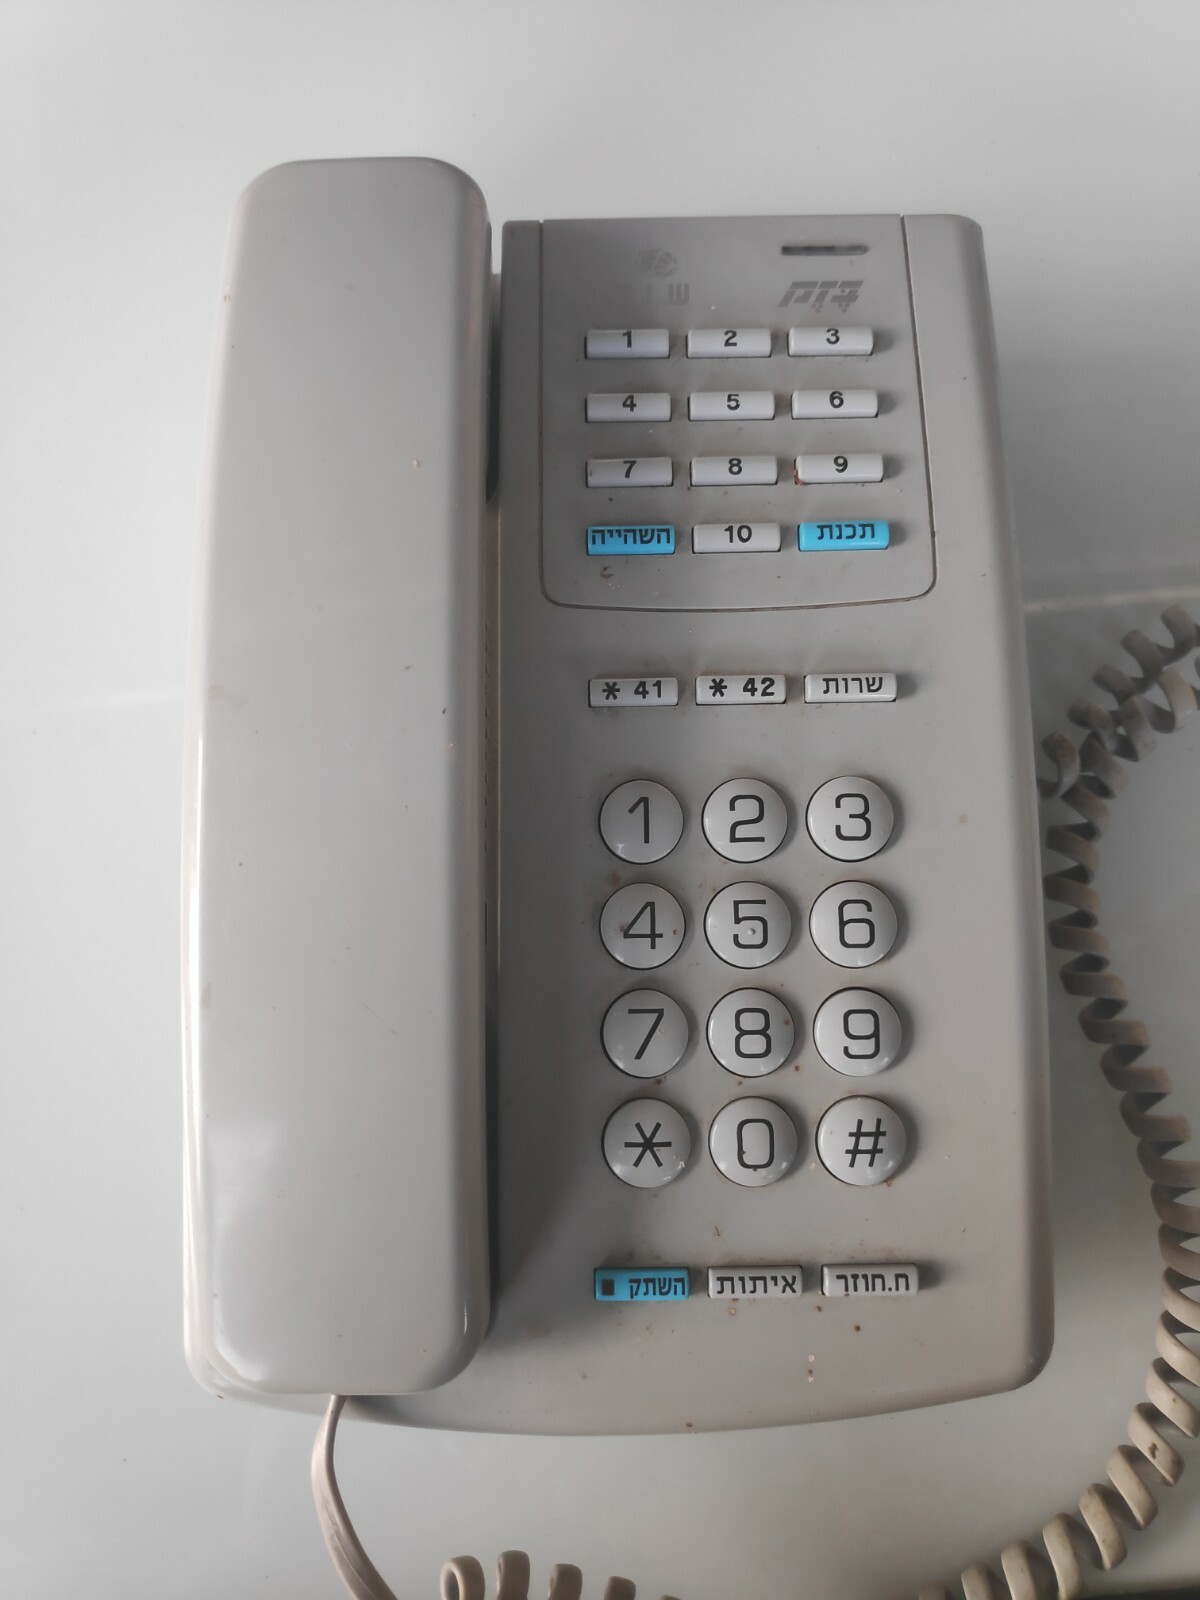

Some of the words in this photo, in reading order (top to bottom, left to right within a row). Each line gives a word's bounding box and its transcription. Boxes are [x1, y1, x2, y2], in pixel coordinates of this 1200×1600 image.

[622, 331, 633, 348] 1
[724, 330, 737, 346] 2
[826, 328, 840, 345] 3
[622, 395, 636, 411] 4
[727, 394, 740, 410] 5
[830, 391, 844, 408] 6
[623, 460, 637, 479] 7
[729, 458, 742, 475] 8
[834, 456, 848, 473] 9
[592, 528, 670, 545] השהייה
[725, 525, 752, 543] 10
[817, 523, 875, 540] תכנת
[634, 680, 661, 699] 41
[743, 677, 775, 696] 42
[823, 677, 883, 694] שרות
[628, 797, 649, 843] 1
[730, 795, 765, 843] 2
[835, 793, 871, 841] 3
[623, 901, 664, 950] 4
[733, 899, 768, 949] 5
[838, 899, 875, 948] 6
[628, 1008, 664, 1059] 7
[735, 1008, 772, 1058] 8
[843, 1009, 880, 1059] 9
[736, 1118, 775, 1170] 0
[845, 1118, 887, 1168] #
[629, 1277, 685, 1297] השתק
[717, 1275, 796, 1294] איתות
[836, 1273, 909, 1292] ח.חוזר
